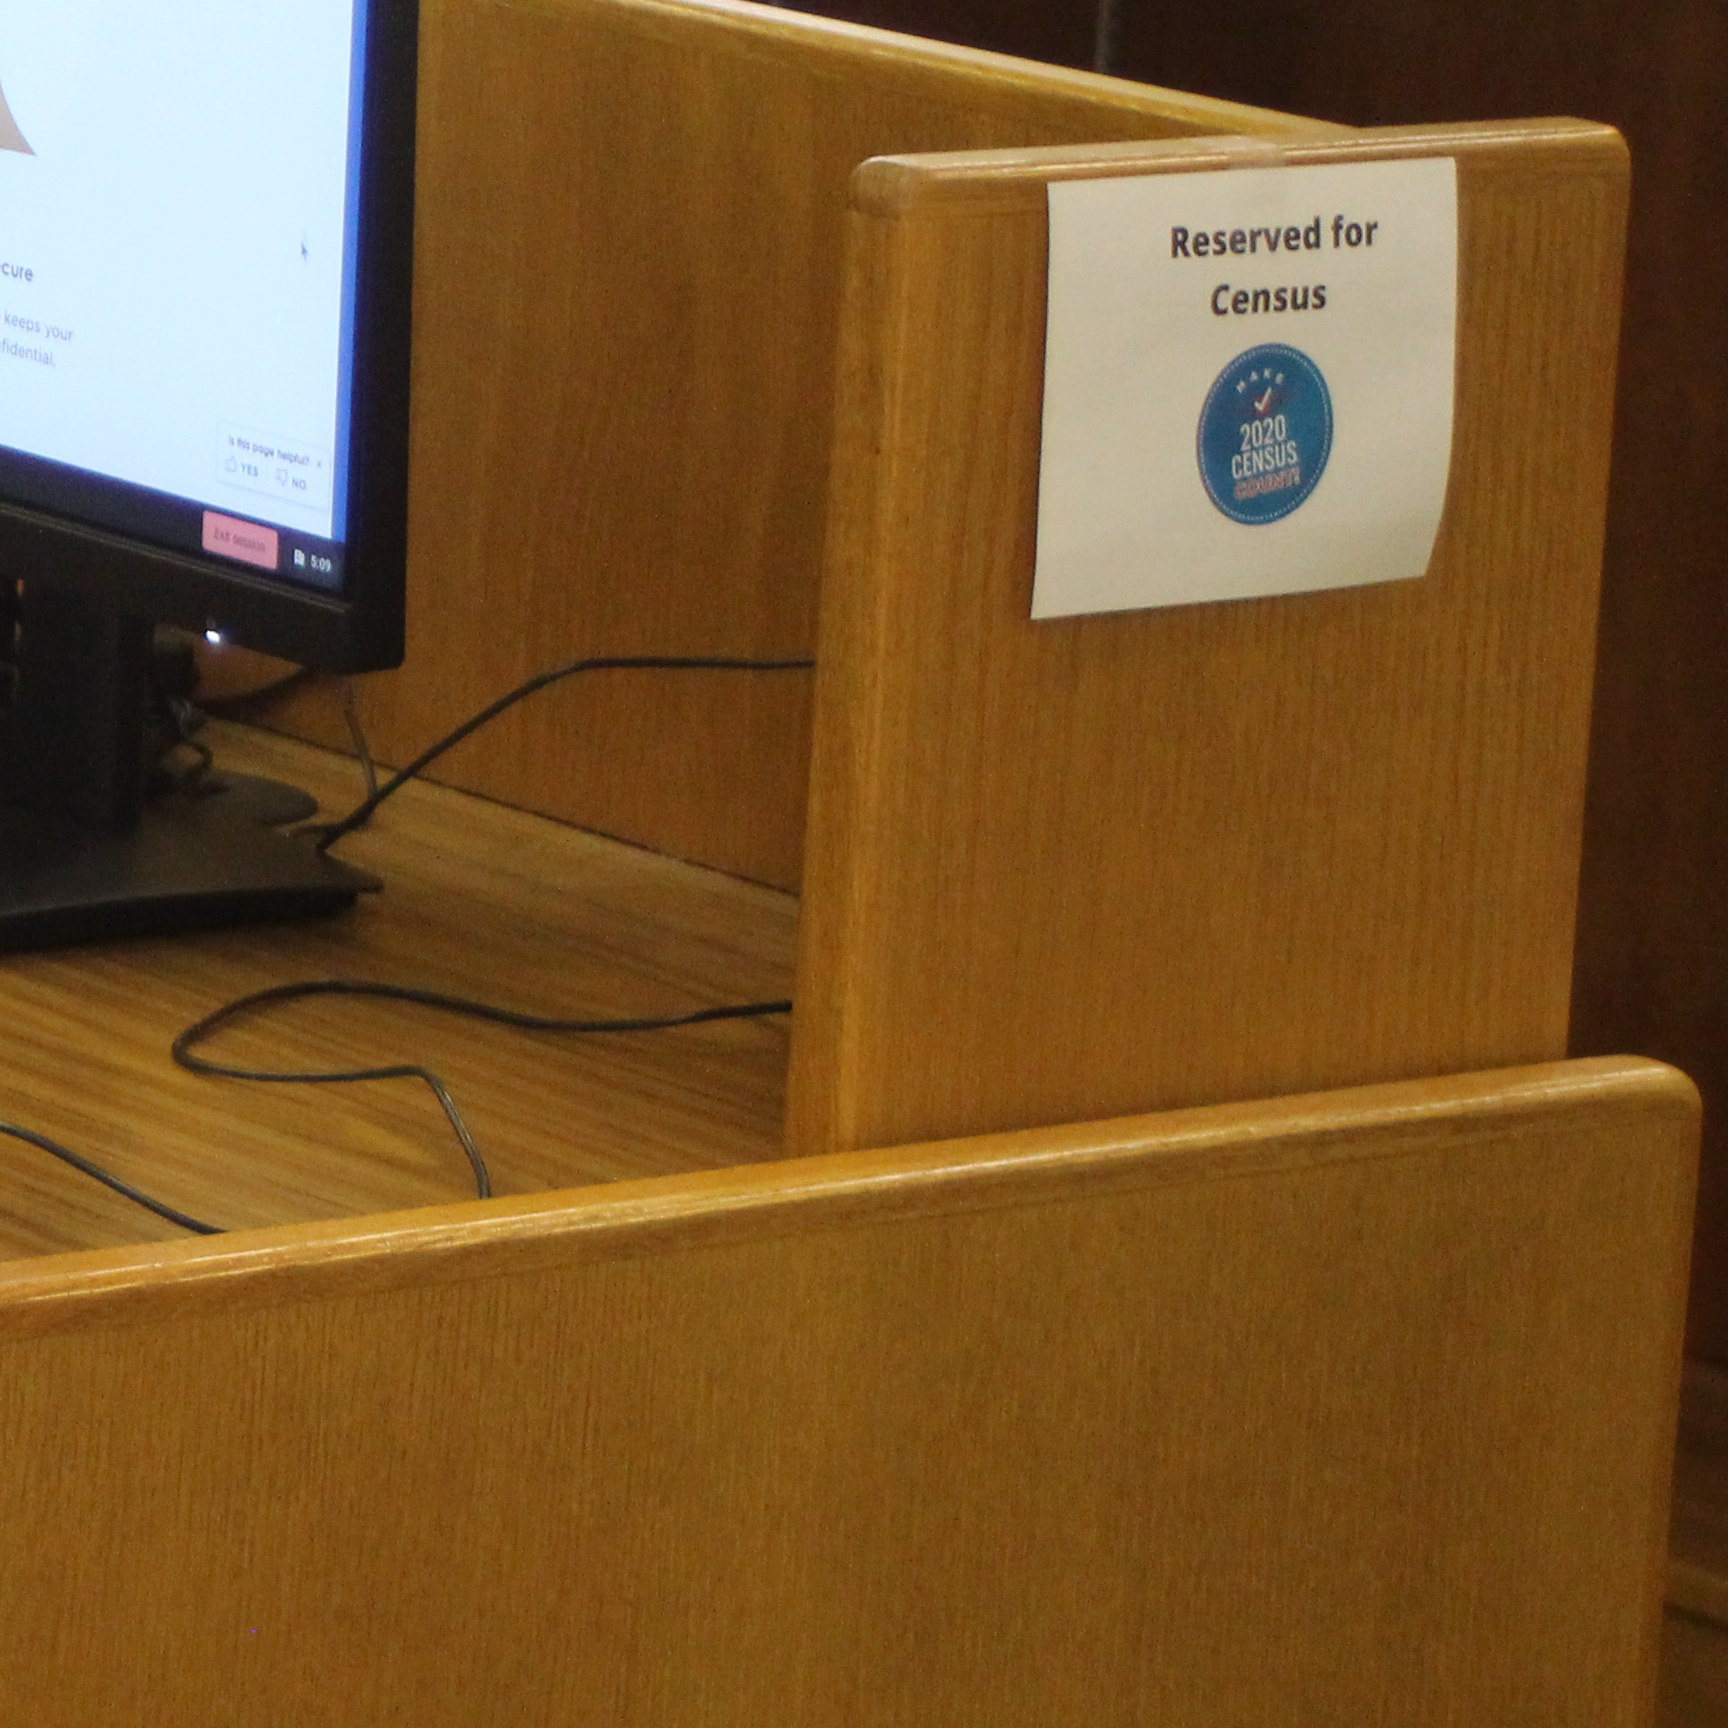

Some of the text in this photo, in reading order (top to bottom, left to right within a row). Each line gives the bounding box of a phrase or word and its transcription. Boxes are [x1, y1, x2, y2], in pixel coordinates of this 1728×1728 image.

[1171, 214, 1379, 259] Reserved for
[1211, 283, 1327, 316] Census
[3, 309, 42, 335] keeps
[43, 323, 74, 343] your
[1235, 367, 1285, 394] MAKE
[1239, 413, 1287, 452] 2020
[228, 434, 310, 465] Is this page helpful?
[1231, 440, 1298, 481] CENSUS
[241, 462, 307, 490] YES NO
[214, 527, 230, 543] Exit
[310, 553, 332, 573] 5:09
